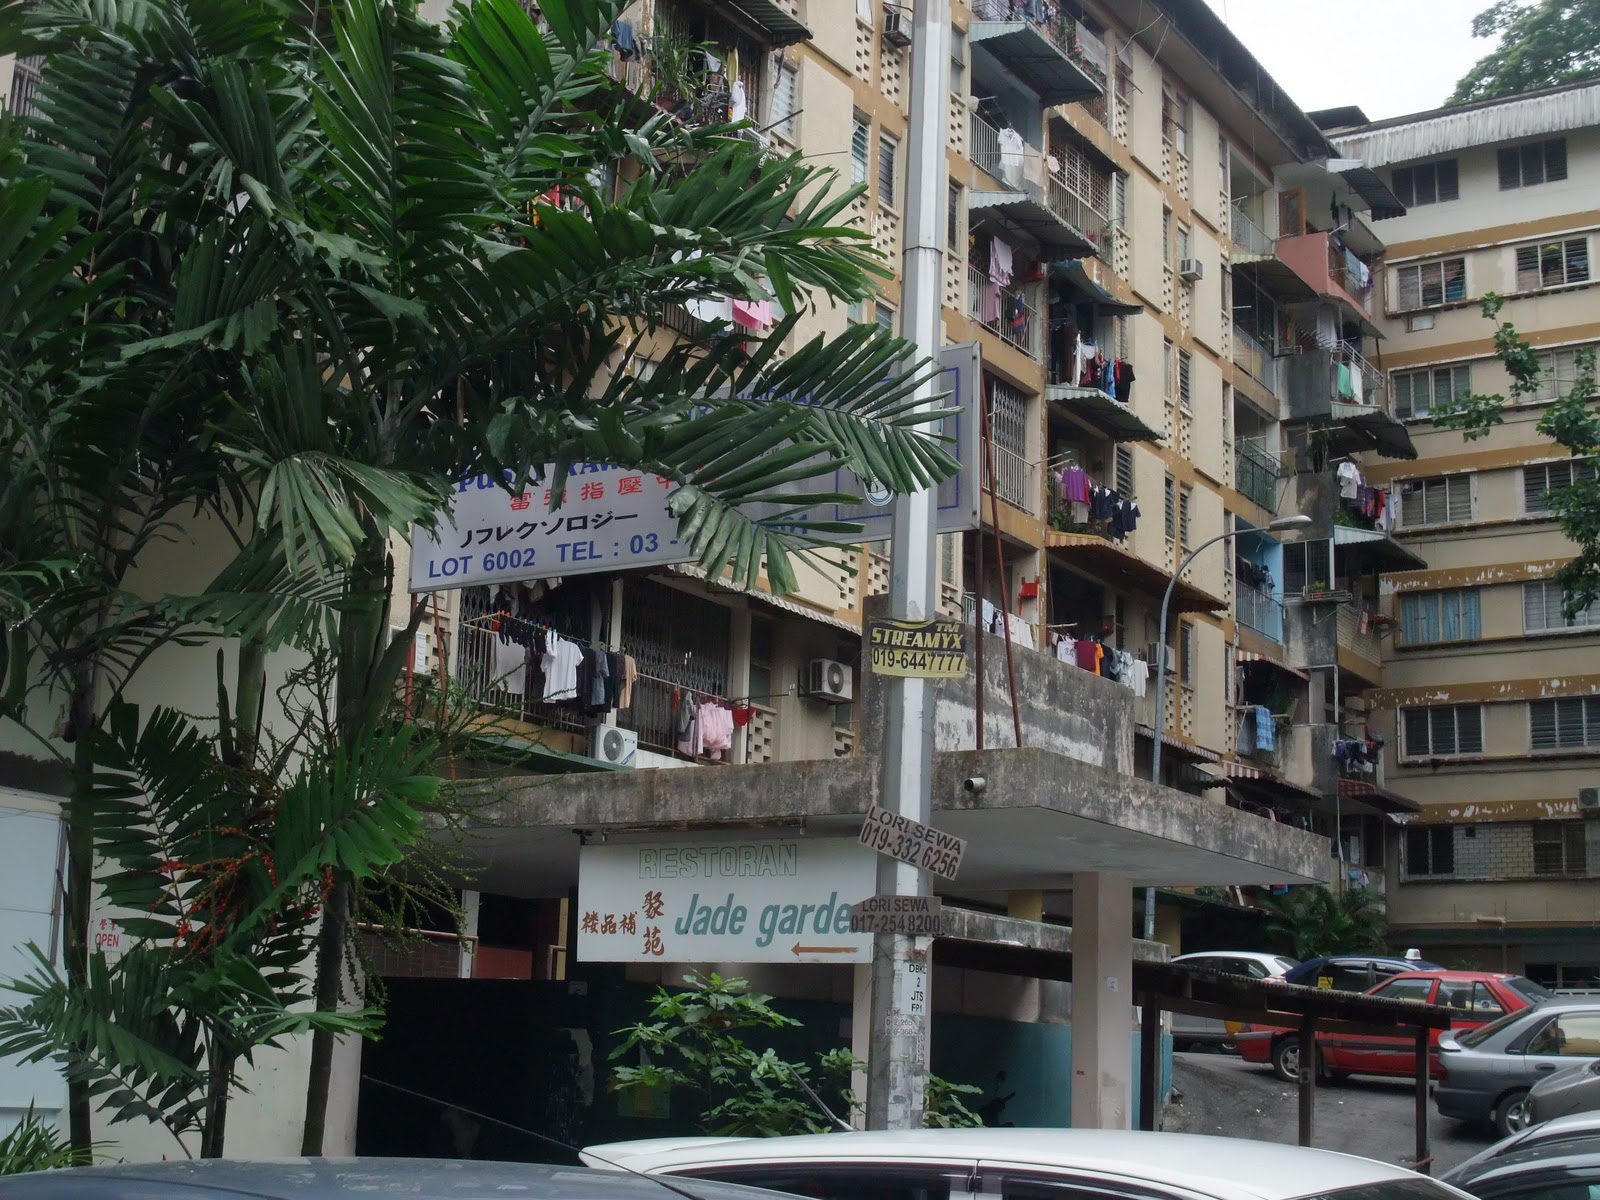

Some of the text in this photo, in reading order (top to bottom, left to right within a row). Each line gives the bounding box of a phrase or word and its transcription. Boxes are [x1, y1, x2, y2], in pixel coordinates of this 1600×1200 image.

[428, 555, 473, 578] LOT
[482, 547, 536, 572] 6002
[555, 540, 603, 563] TEL
[629, 533, 659, 555] 03
[871, 627, 963, 649] STREAMYX
[936, 623, 960, 633] TM
[873, 648, 963, 671] 019-6447777
[868, 806, 961, 856] LORI SEWA
[638, 843, 798, 879] RESTORAN
[861, 898, 929, 912] LORI SEWA
[674, 890, 853, 948] Jade garde
[95, 932, 120, 948] OPEN
[916, 976, 921, 988] 2
[911, 991, 923, 1002] JTS
